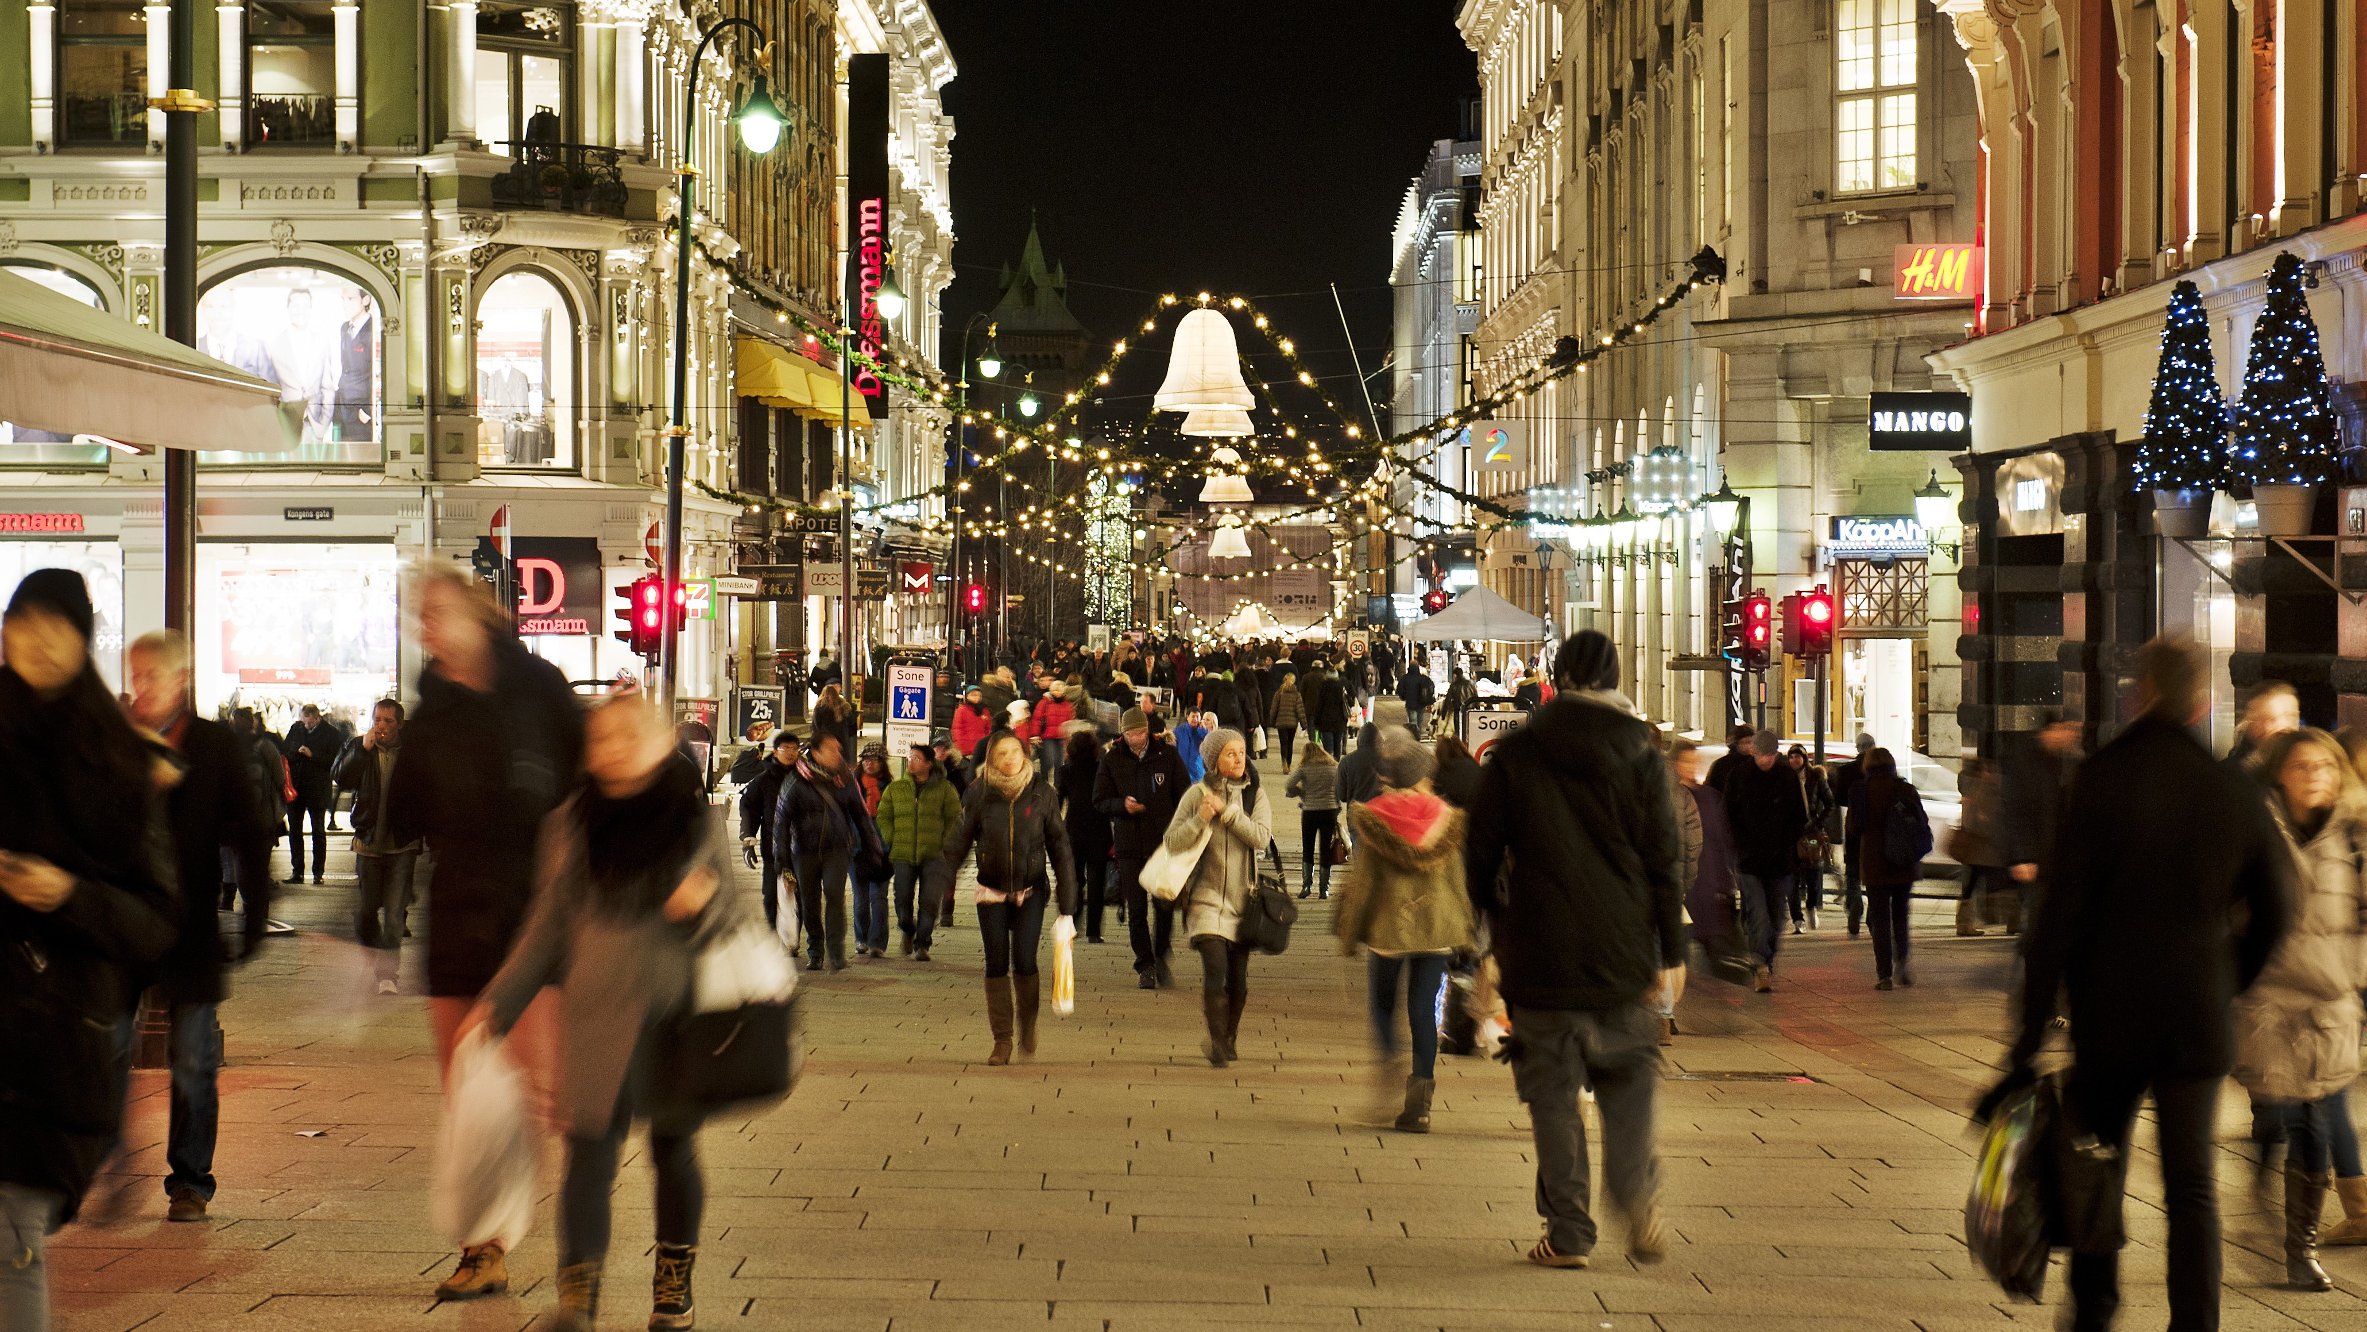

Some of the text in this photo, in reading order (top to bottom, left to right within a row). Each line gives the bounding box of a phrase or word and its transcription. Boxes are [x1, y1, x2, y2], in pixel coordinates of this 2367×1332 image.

[1901, 247, 1971, 294] H&M
[1873, 411, 1964, 432] MANGO
[1485, 428, 1512, 463] 2
[287, 509, 314, 520] Kongens
[784, 516, 839, 531] APOTE
[1839, 518, 1927, 546] KappAh
[718, 581, 755, 589] MINIBANK
[897, 670, 925, 681] Sone
[741, 690, 754, 698] STOR
[1478, 715, 1519, 730] Sone
